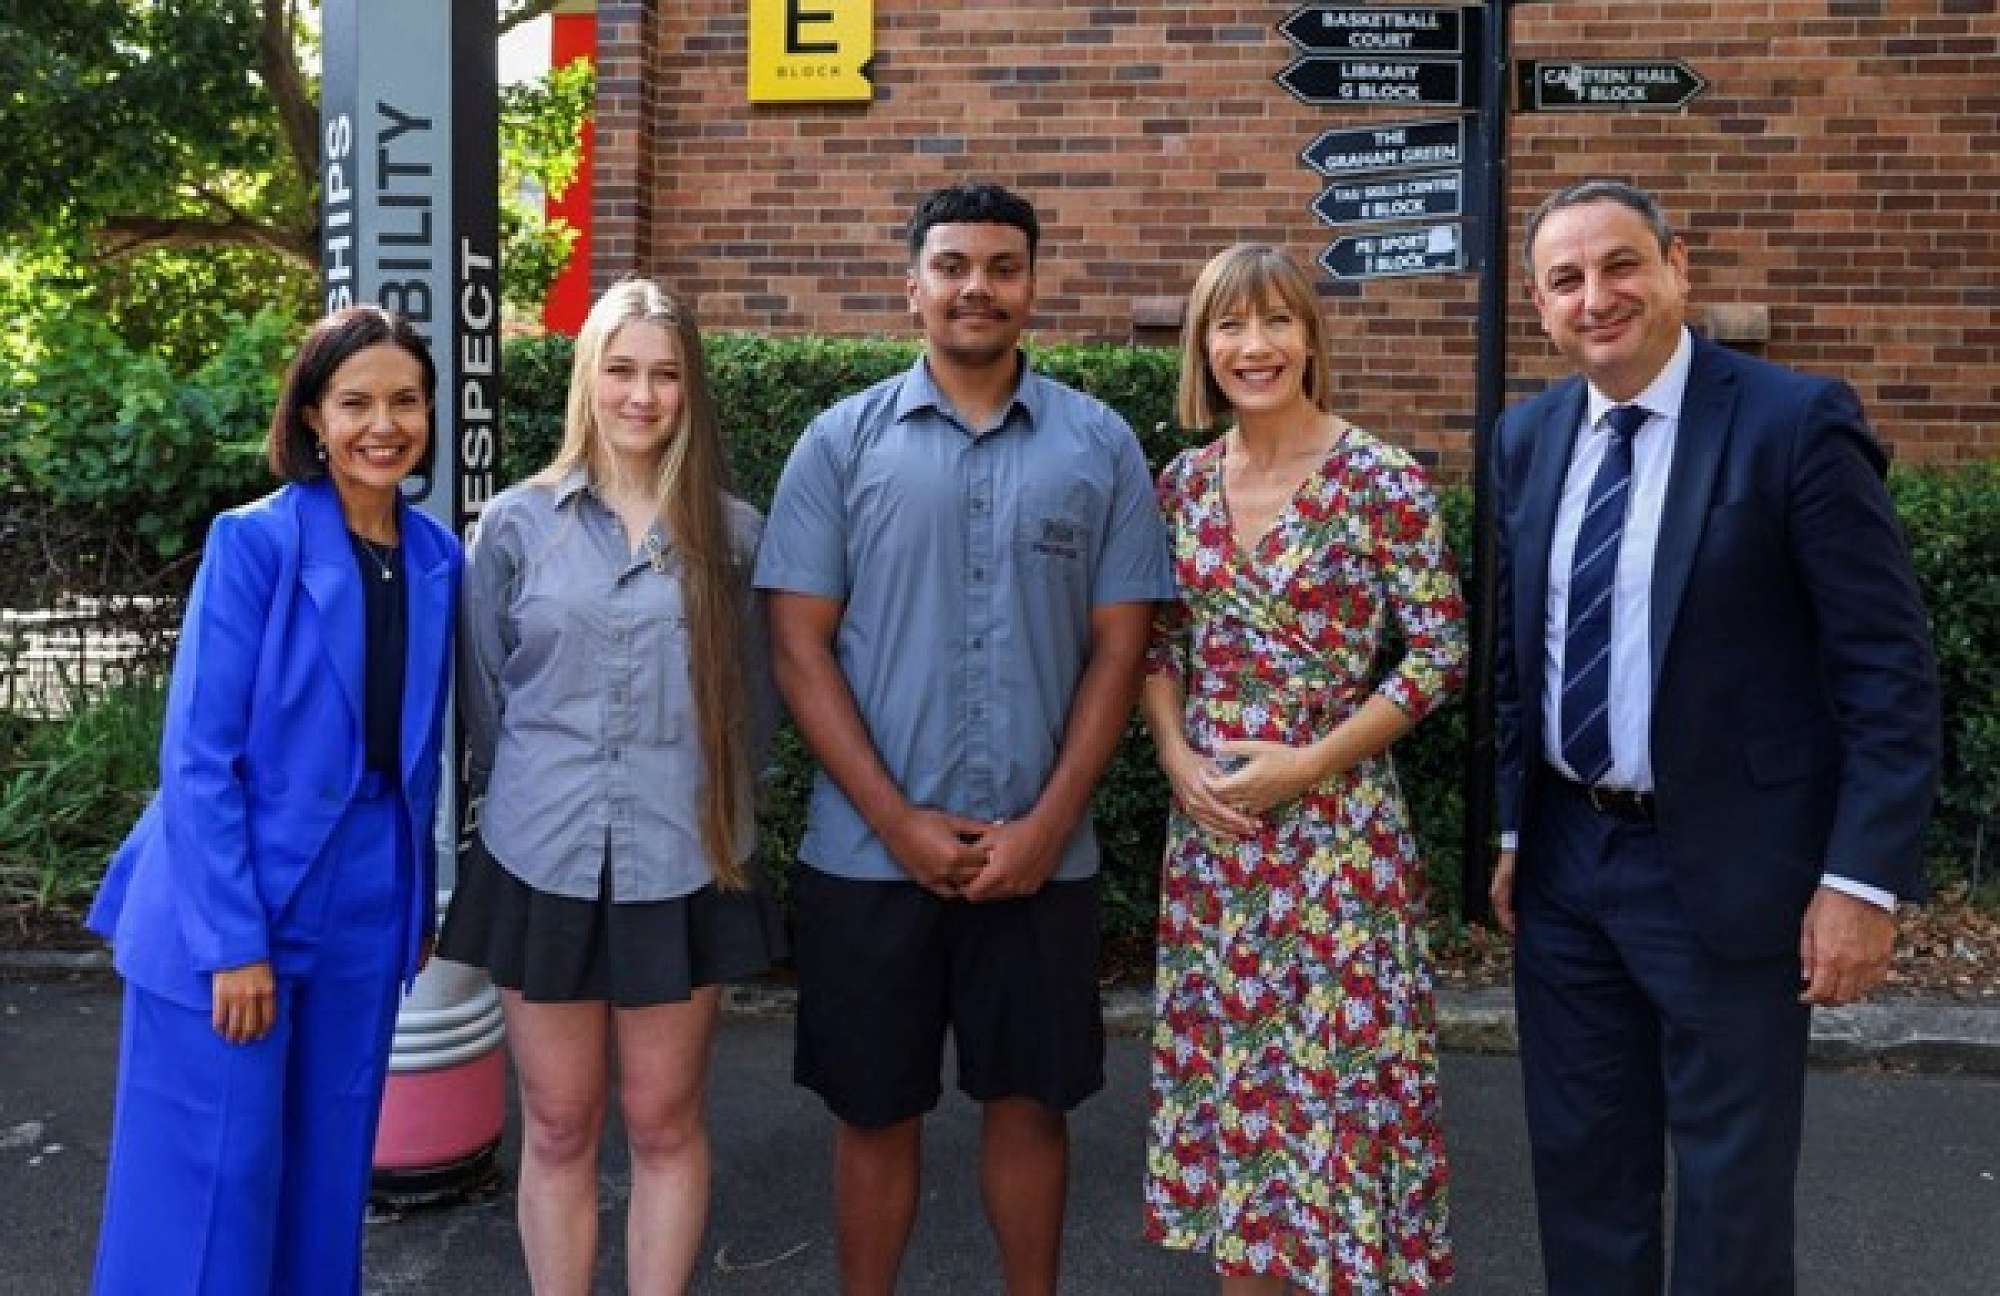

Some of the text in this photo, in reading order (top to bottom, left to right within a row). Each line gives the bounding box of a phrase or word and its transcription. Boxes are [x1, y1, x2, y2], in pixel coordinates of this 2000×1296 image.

[785, 0, 839, 53] E
[1322, 12, 1440, 29] BASKETBALL
[1349, 33, 1415, 48] COURT
[777, 66, 840, 77] BLOCK
[1341, 62, 1420, 80] LIBRARY
[1634, 69, 1679, 84] HALL
[1339, 83, 1420, 99] G BLOCK
[1589, 86, 1648, 101] BLOCK
[1373, 130, 1406, 146] THE
[1325, 144, 1456, 169] GRAHAM GREEN
[1374, 199, 1425, 217] BLOCK
[376, 101, 433, 345] BILITY
[1376, 253, 1425, 271] BLOCK
